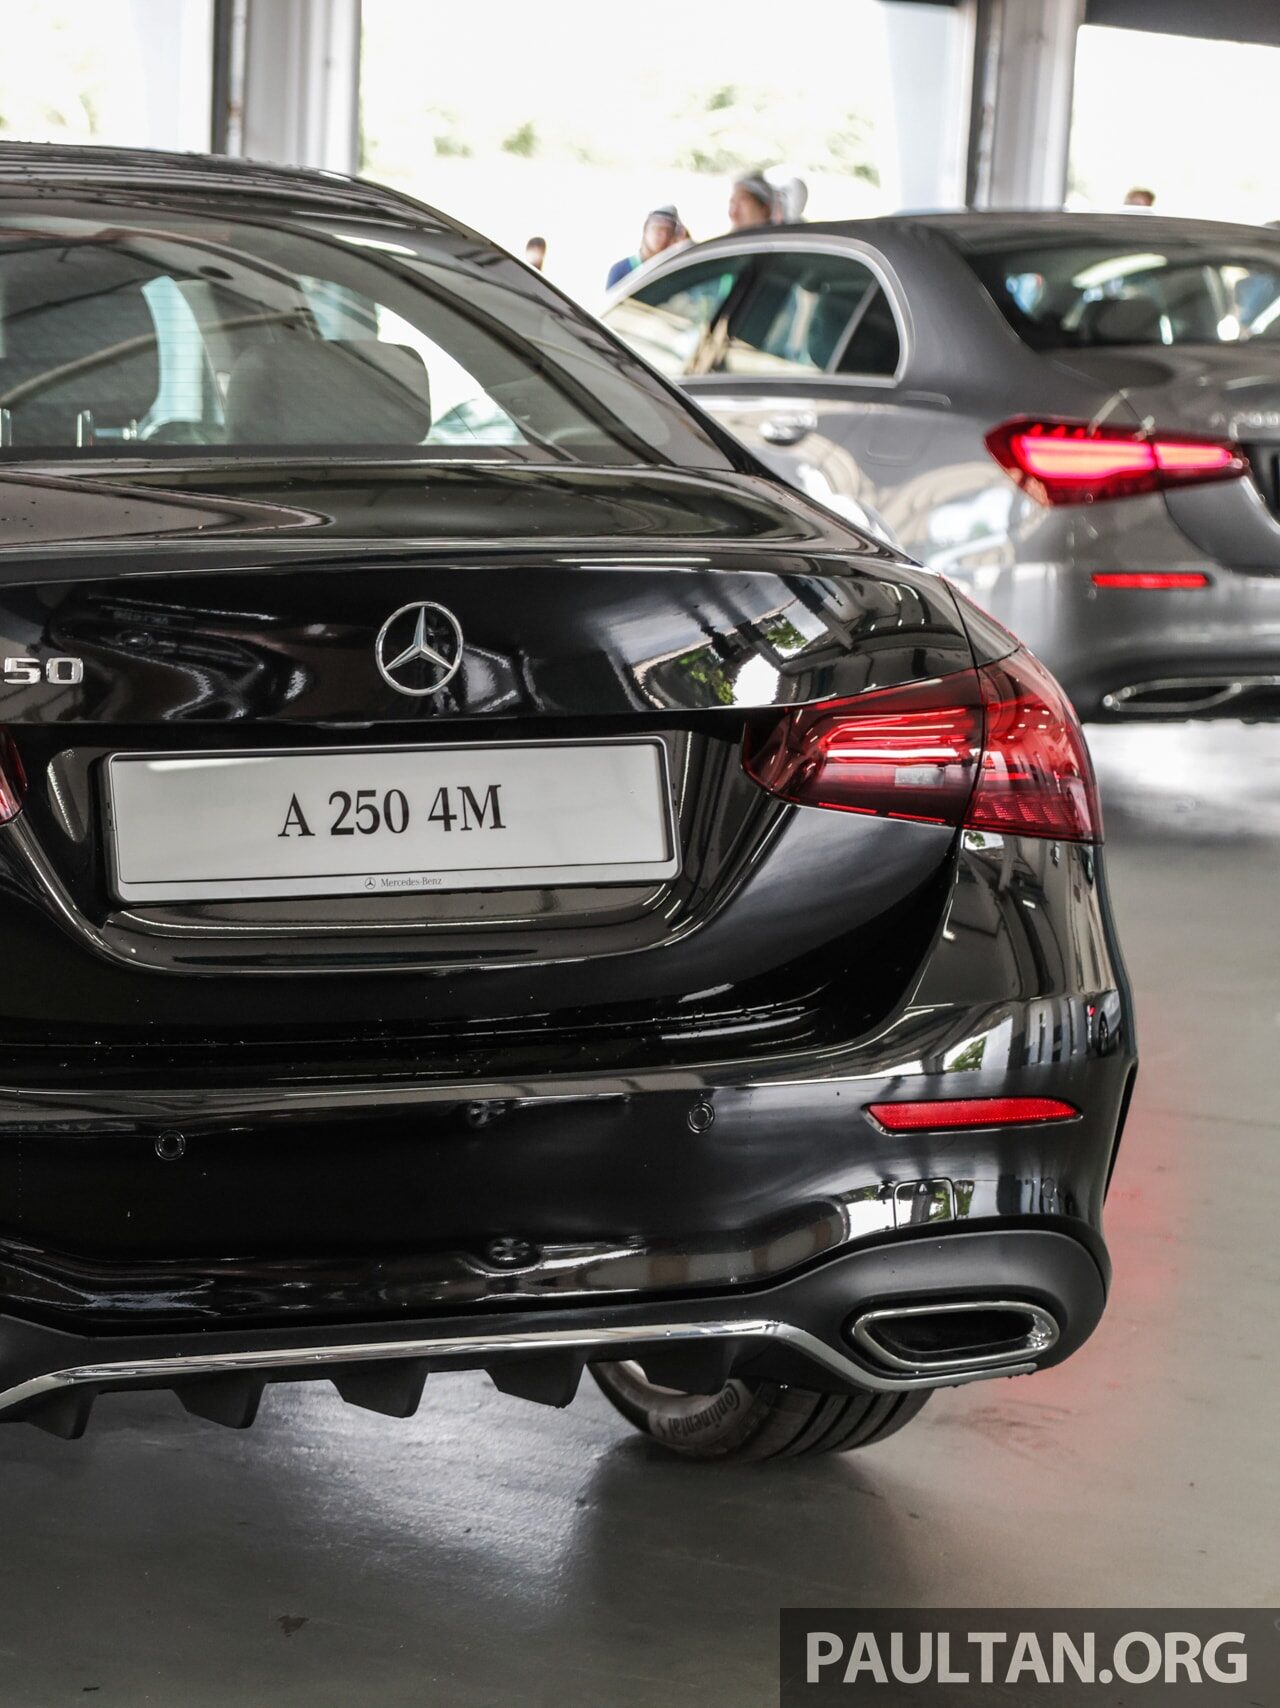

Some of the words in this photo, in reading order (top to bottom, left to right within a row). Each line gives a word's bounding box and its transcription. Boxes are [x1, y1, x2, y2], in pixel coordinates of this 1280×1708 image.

[277, 792, 316, 838] A
[328, 788, 410, 836] 250
[427, 784, 507, 832] 4M
[380, 876, 442, 887] Mercedes-Benz
